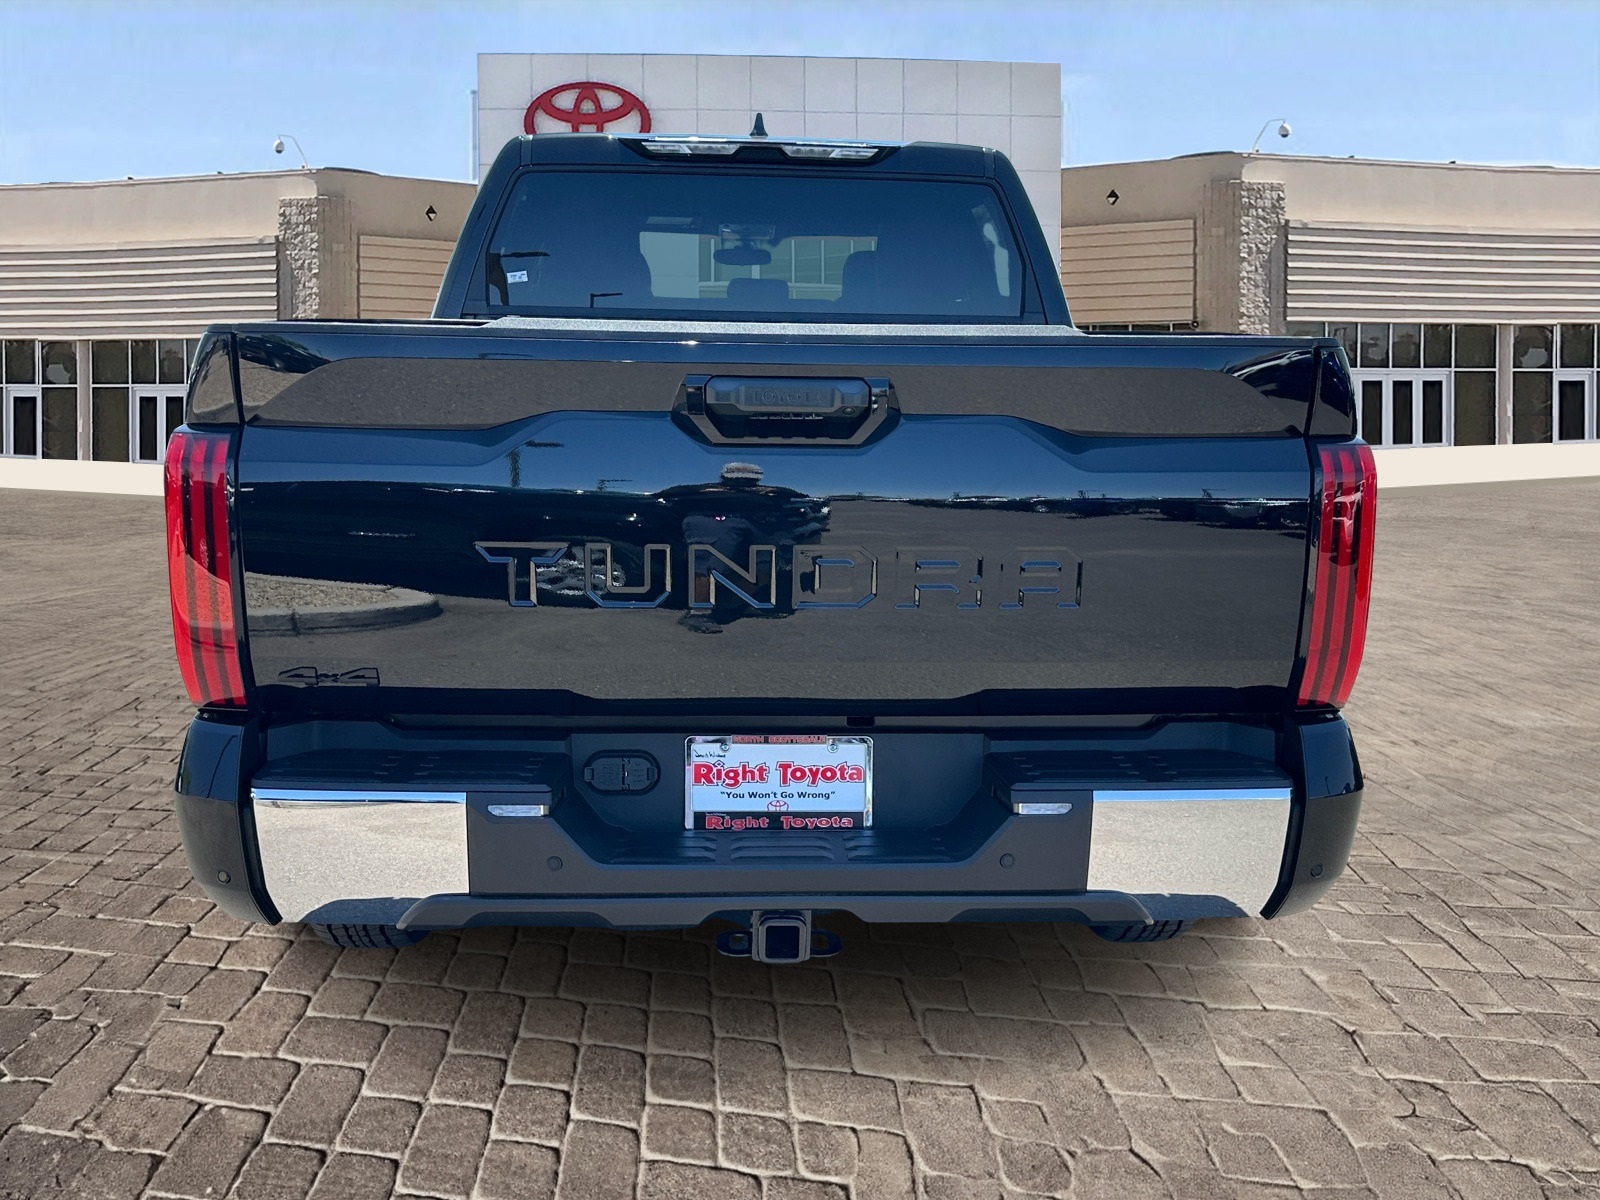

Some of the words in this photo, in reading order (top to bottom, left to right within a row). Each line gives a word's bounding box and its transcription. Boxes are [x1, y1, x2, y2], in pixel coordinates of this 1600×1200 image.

[753, 389, 824, 404] TOYOTA
[474, 541, 1083, 609] TUNDRA
[692, 760, 770, 789] Right
[776, 761, 865, 787] Toyota
[780, 791, 794, 799] Go
[705, 815, 769, 831] Right
[780, 815, 854, 830] Toyota
